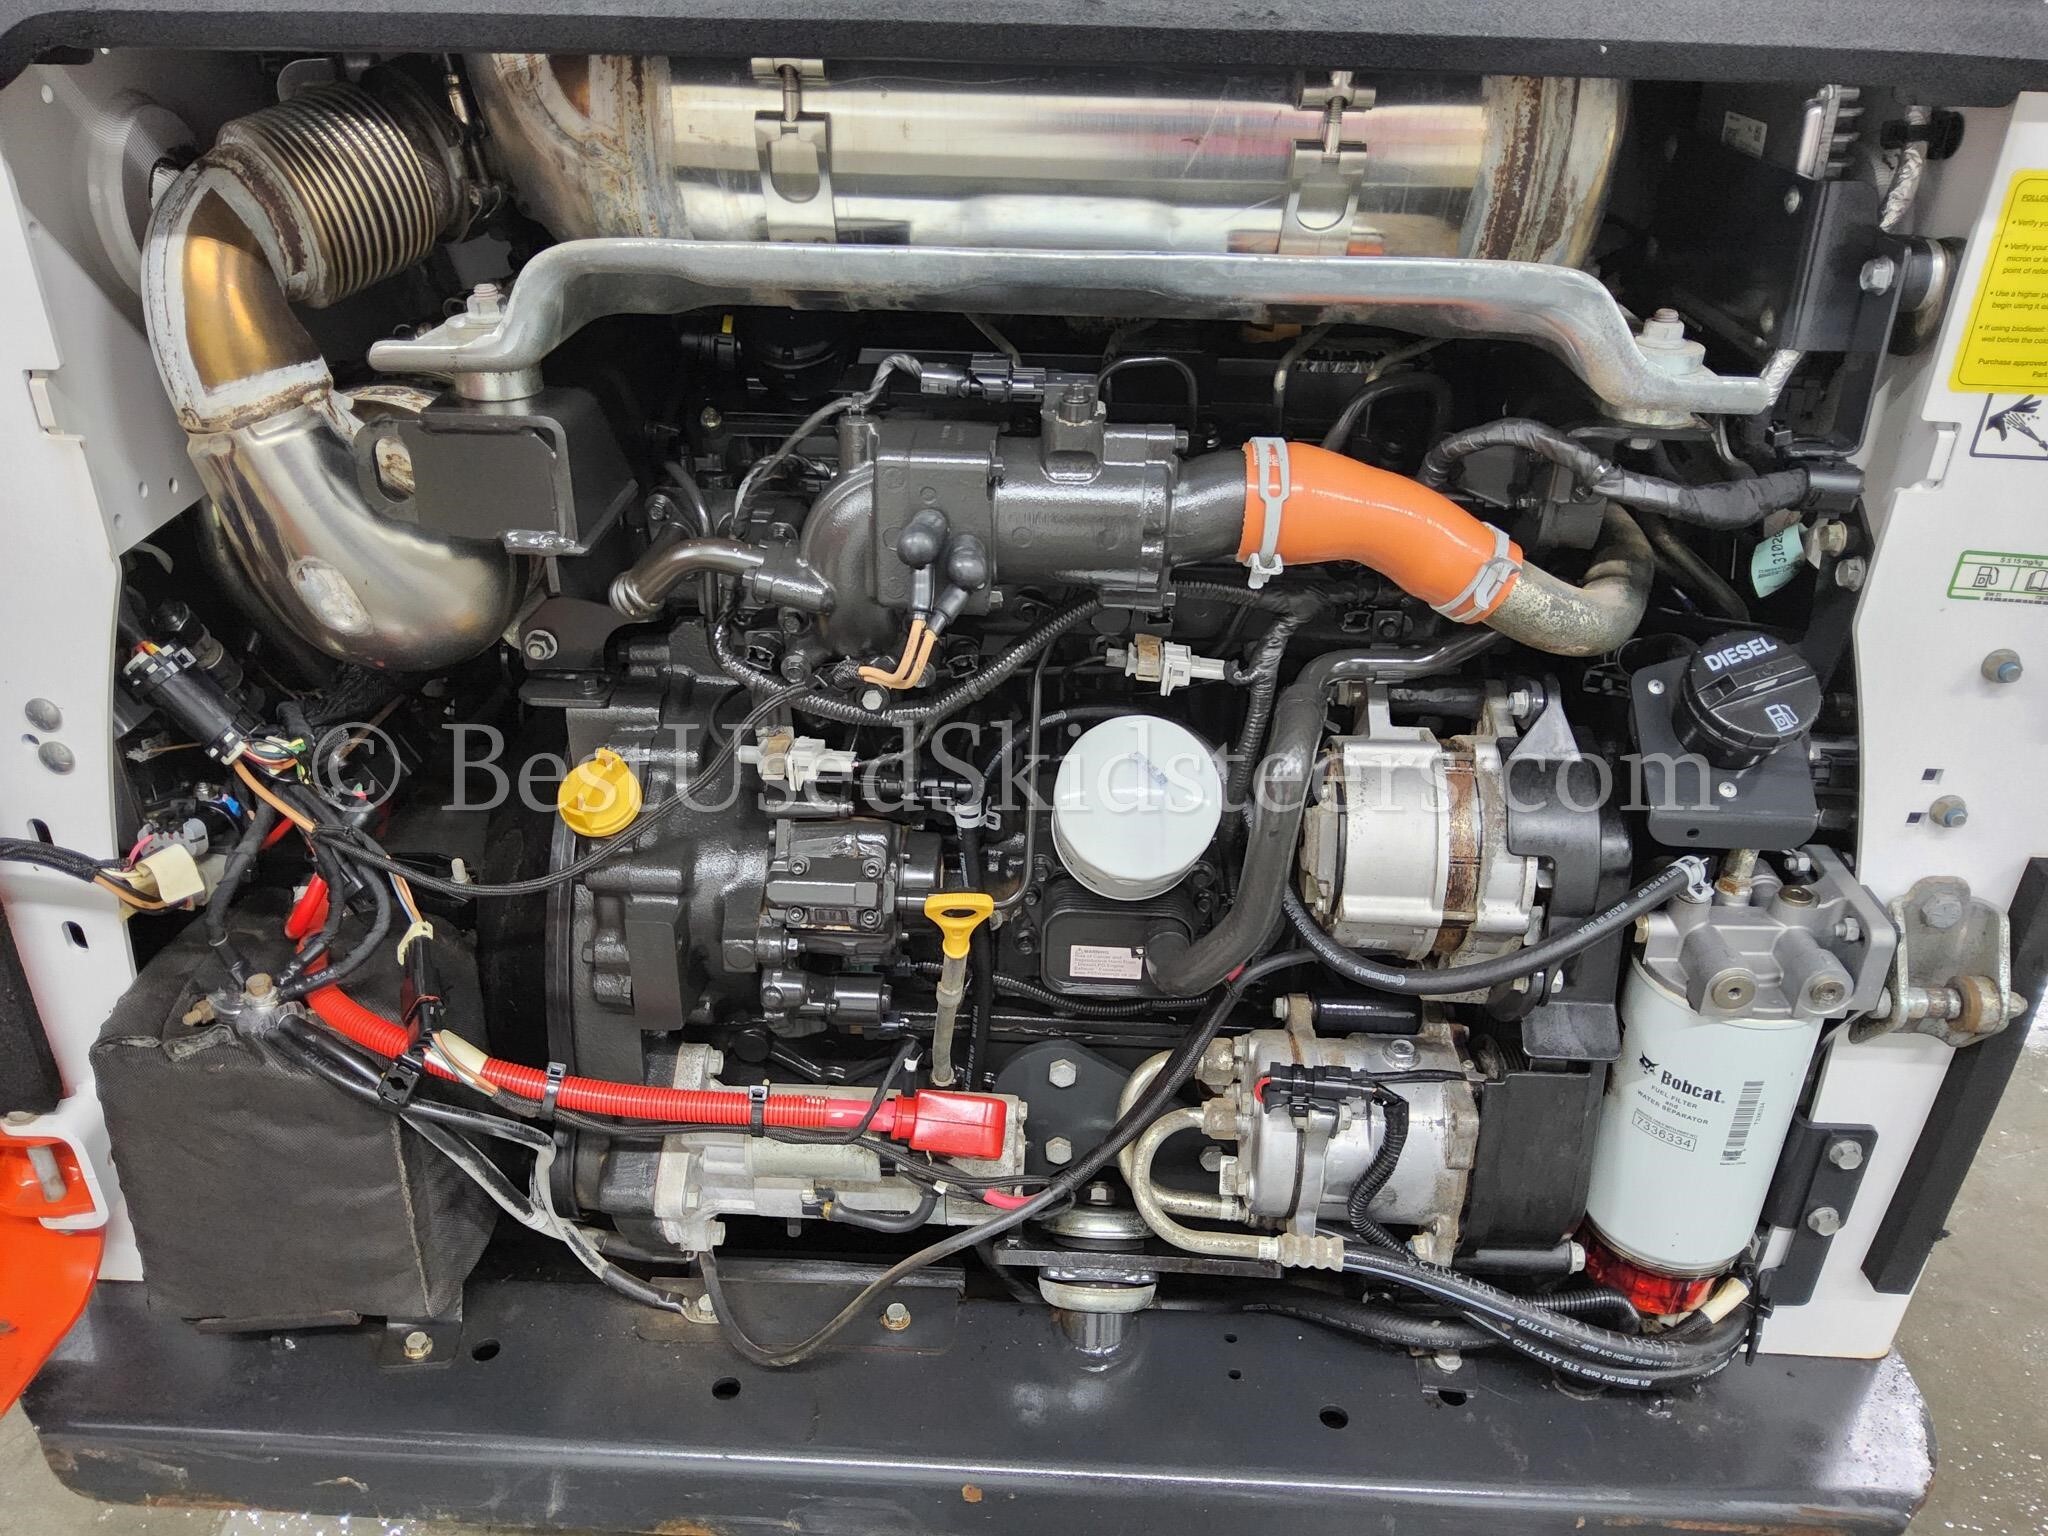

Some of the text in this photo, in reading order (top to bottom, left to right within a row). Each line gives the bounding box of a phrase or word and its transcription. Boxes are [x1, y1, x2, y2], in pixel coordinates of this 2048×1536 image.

[1703, 636, 1778, 672] DIESEL
[1637, 888, 1650, 899] WP
[1577, 901, 1629, 936] MADE IN USA
[1360, 966, 1406, 987] Continental
[1650, 1084, 1699, 1110] FUEL FILTER
[1660, 1069, 1723, 1104] Bobcat
[1636, 1089, 1710, 1126] WATER SEPARATOR
[1664, 1099, 1679, 1110] and
[1636, 1115, 1692, 1149] 7336334
[1516, 1317, 1561, 1340] GALAX
[1598, 1348, 1613, 1359] A/C
[1612, 1352, 1635, 1363] HOSE
[1512, 1337, 1562, 1366] GALAXY
[1562, 1360, 1580, 1373] SLE
[1580, 1367, 1601, 1379] 4890
[1601, 1373, 1617, 1383] A/C
[1616, 1376, 1640, 1386] HOSE
